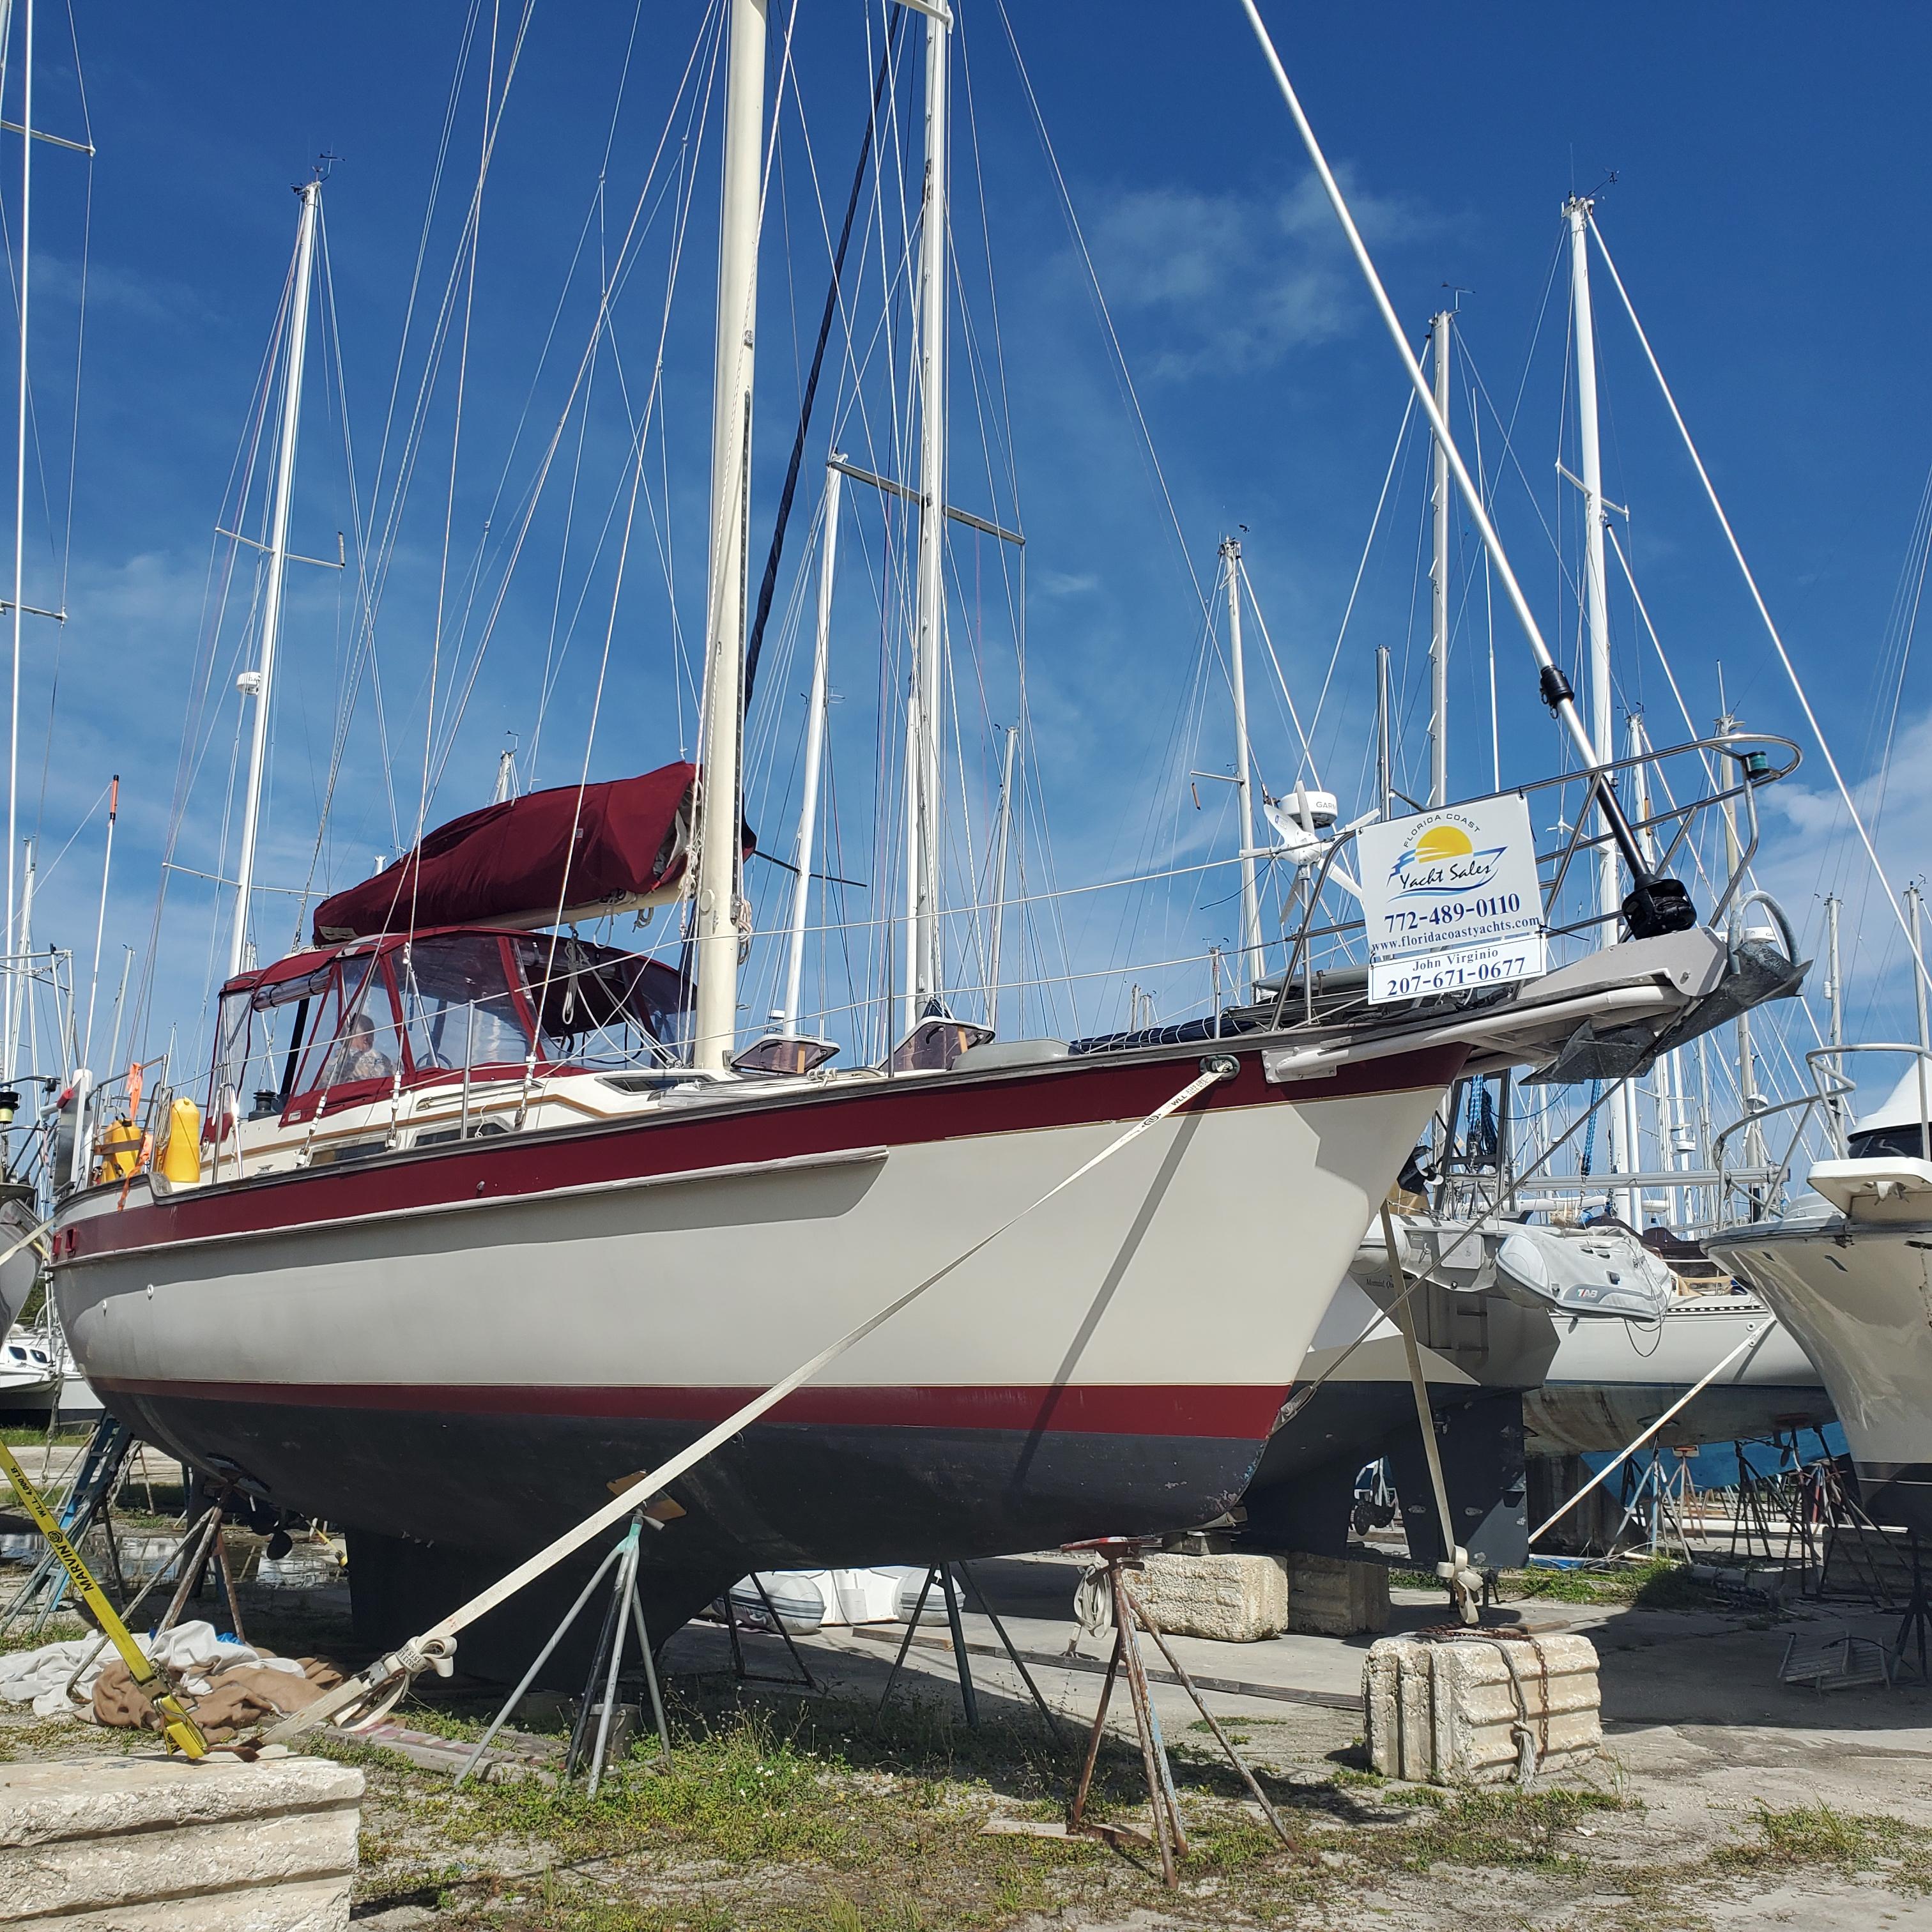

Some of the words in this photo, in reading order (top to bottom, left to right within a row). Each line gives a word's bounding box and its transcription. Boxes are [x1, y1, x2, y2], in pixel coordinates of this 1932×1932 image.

[1403, 815, 1441, 848] FLORIDA
[1446, 813, 1480, 832] COAST
[1400, 868, 1444, 889] Yacht
[1450, 860, 1491, 880] Sales
[1384, 893, 1520, 933] 772-489-0110
[1372, 916, 1540, 952] www.floridacoastyachts.com
[1386, 956, 1526, 997] 207-671-0677
[1412, 959, 1441, 971] John
[1446, 948, 1499, 964] Virginio
[1170, 1094, 1188, 1106] WLL
[18, 1478, 33, 1496] 4,000
[57, 1544, 95, 1592] MARVIN
